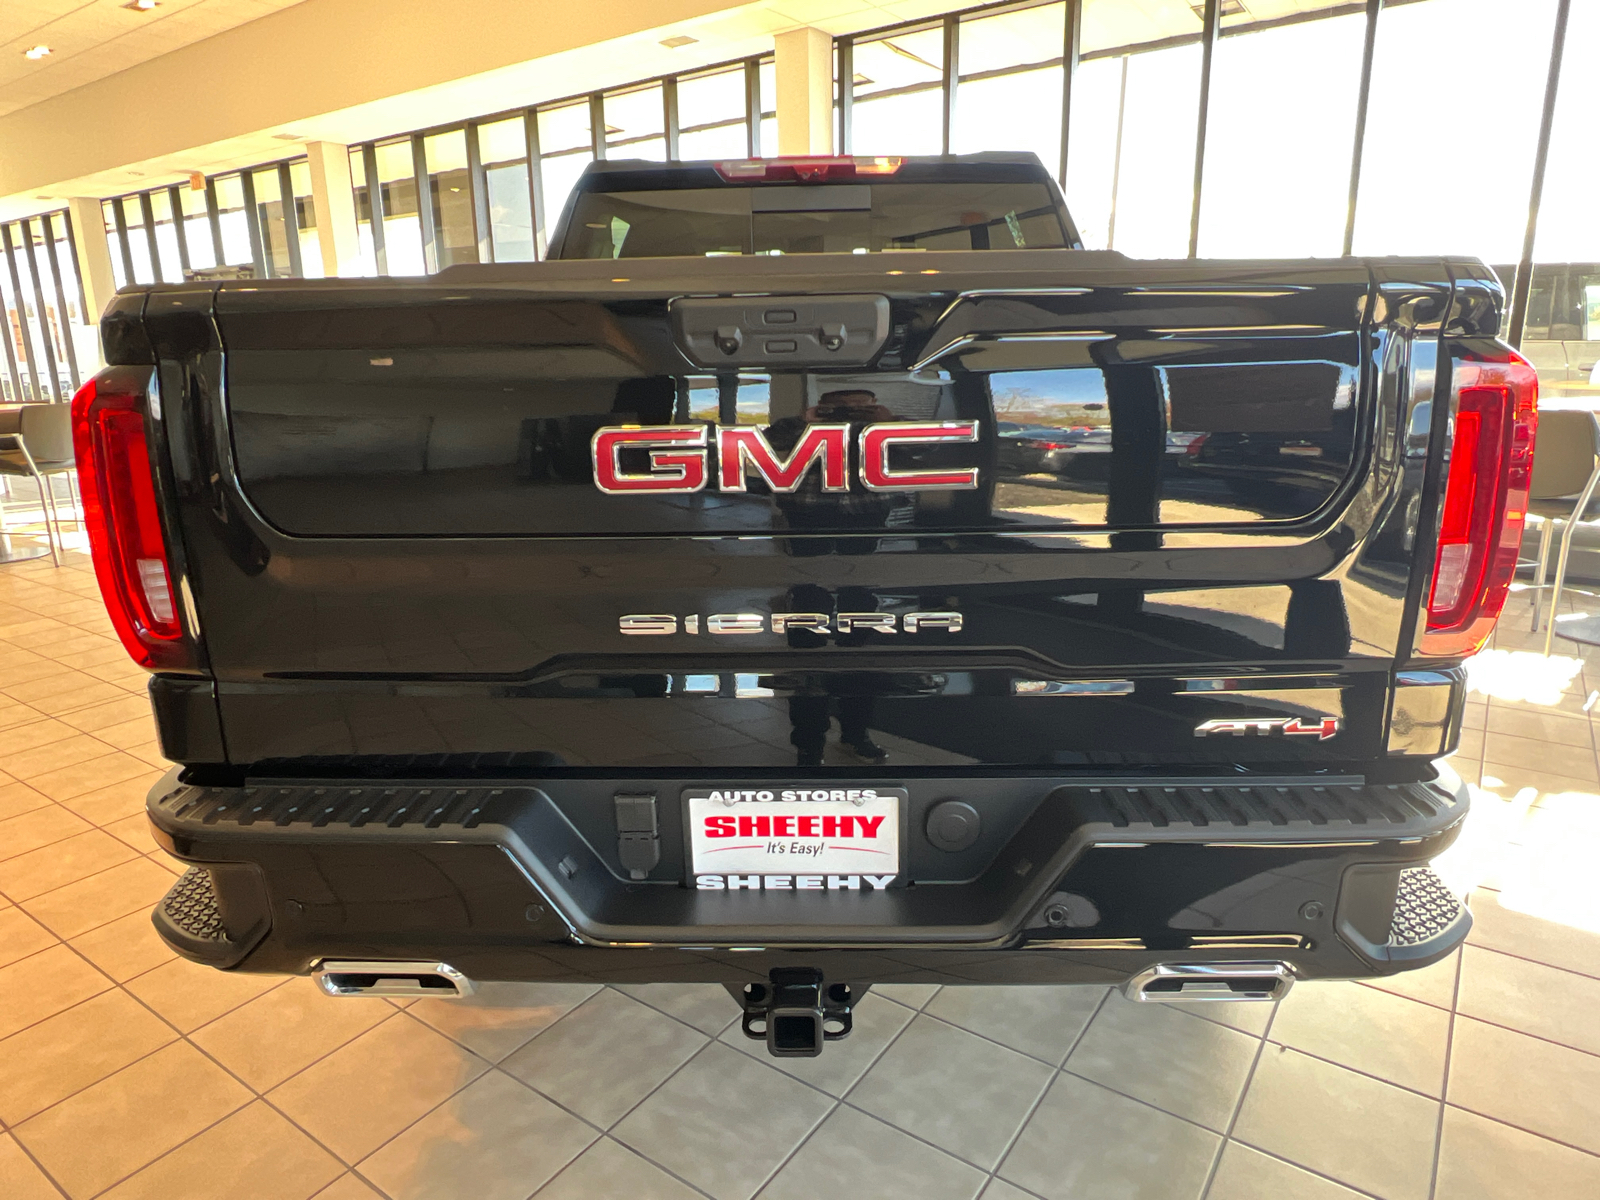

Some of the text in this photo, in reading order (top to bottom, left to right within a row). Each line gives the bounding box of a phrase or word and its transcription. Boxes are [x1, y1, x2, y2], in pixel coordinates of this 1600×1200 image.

[592, 420, 980, 495] GMC
[619, 612, 964, 636] SIERRA
[1194, 717, 1339, 741] AT4
[708, 789, 877, 802] AUTO STORES
[704, 815, 886, 839] SHEEHY
[767, 841, 825, 857] It's Easy!
[696, 874, 896, 890] SHEEHY
